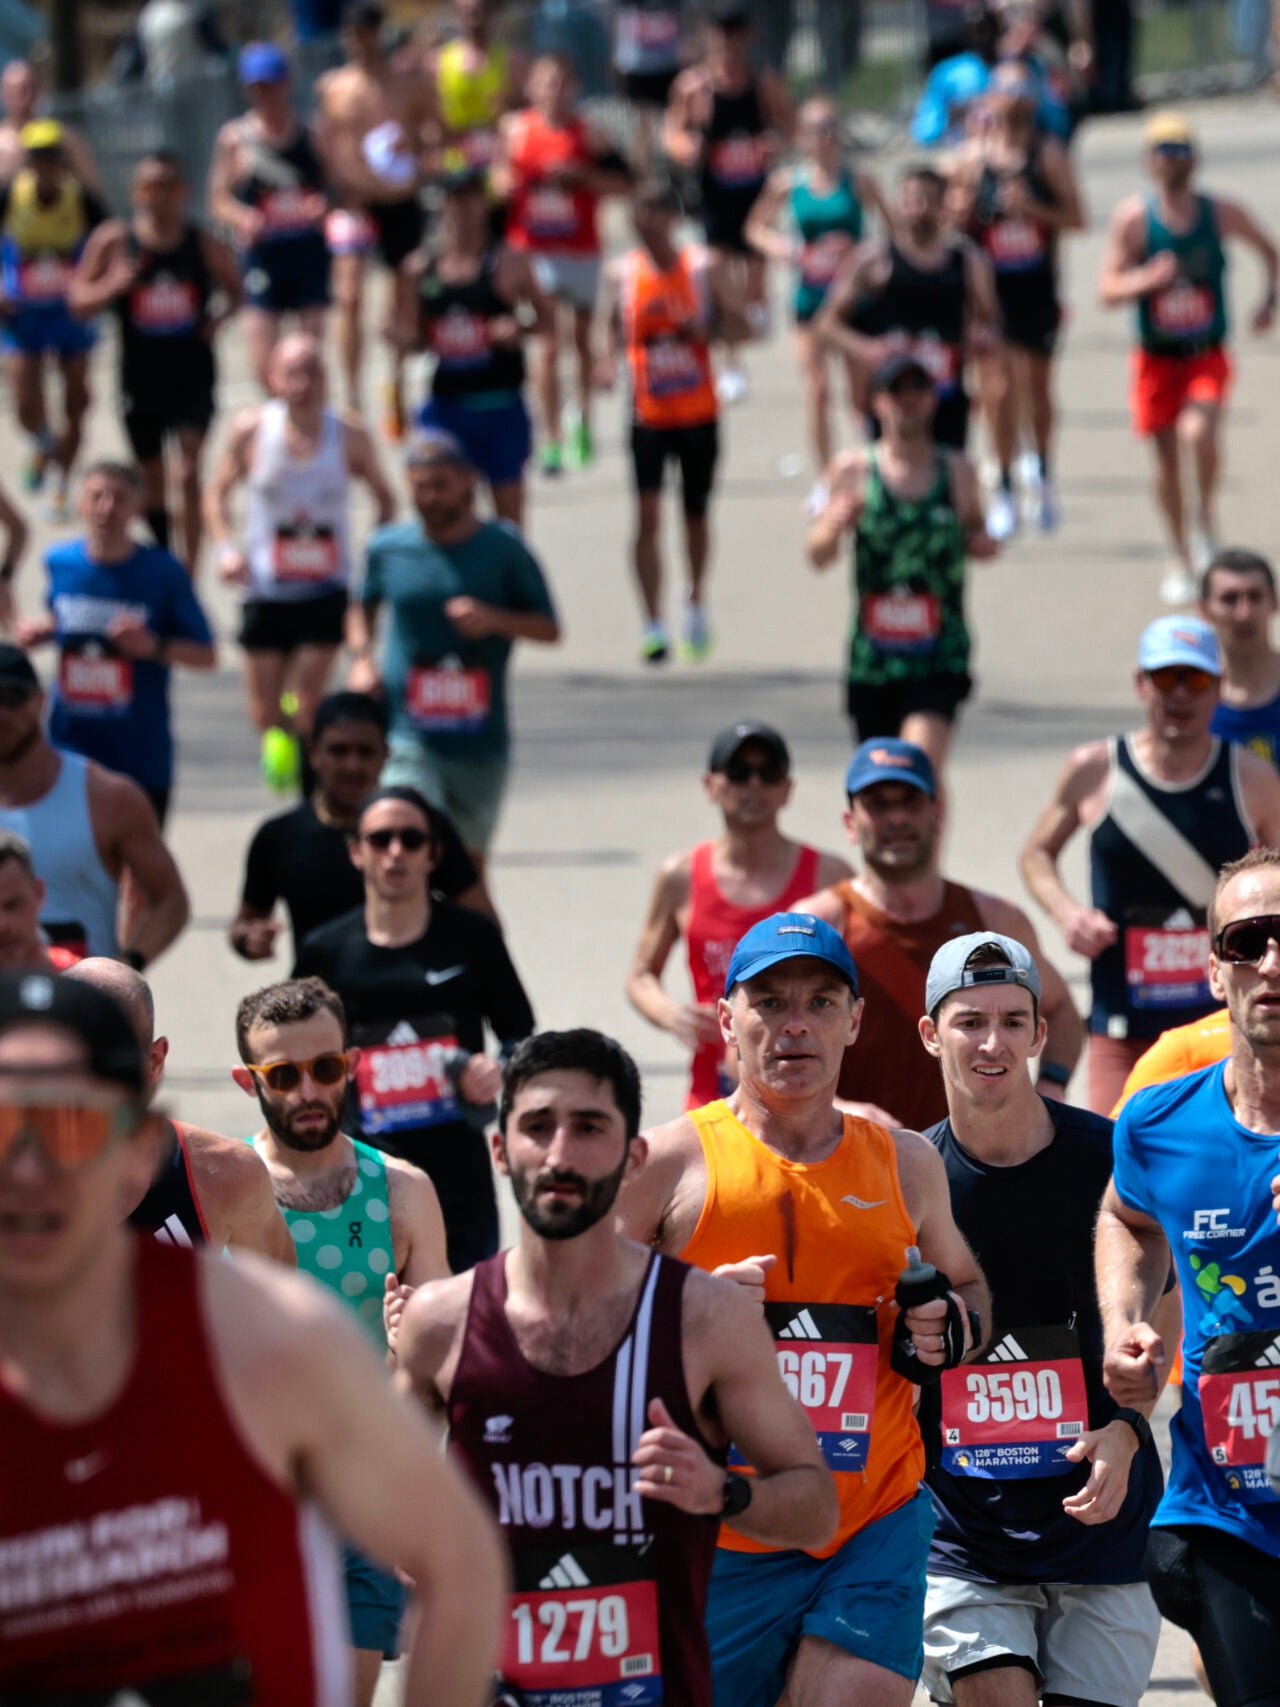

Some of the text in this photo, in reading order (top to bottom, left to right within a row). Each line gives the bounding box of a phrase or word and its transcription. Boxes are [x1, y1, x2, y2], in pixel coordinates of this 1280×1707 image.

[1194, 1208, 1230, 1231] FC
[776, 1350, 853, 1408] 667
[966, 1369, 1063, 1423] 3590
[948, 1430, 958, 1442] 4
[975, 1456, 1040, 1467] MARATHON
[997, 1446, 1039, 1457] BOSTON
[1216, 1449, 1225, 1462] 5
[490, 1461, 644, 1531] NOTCH
[511, 1595, 630, 1664] 1279
